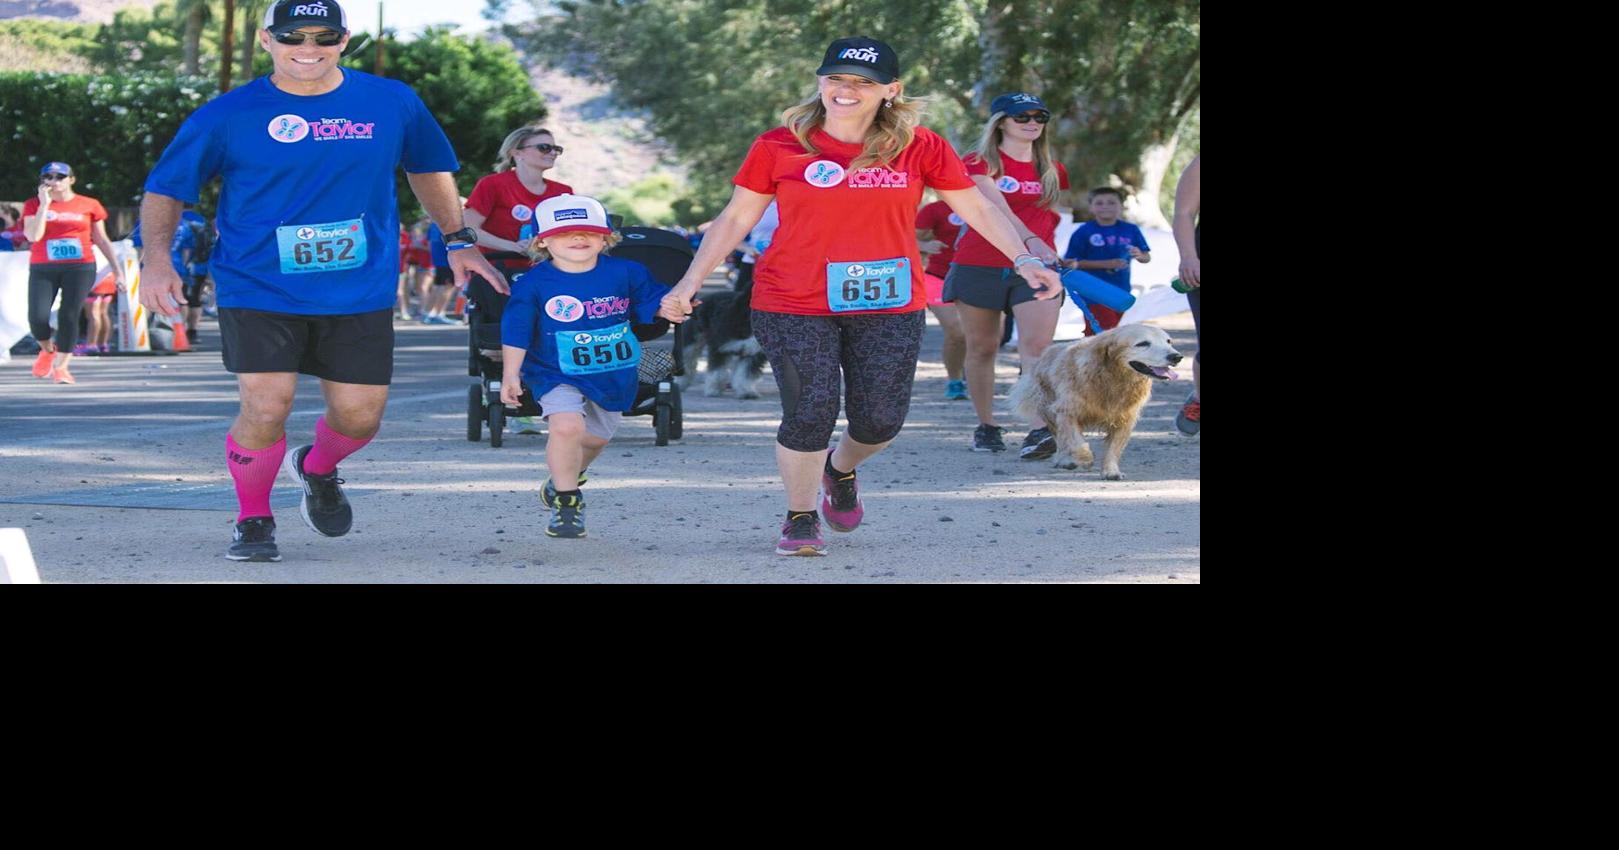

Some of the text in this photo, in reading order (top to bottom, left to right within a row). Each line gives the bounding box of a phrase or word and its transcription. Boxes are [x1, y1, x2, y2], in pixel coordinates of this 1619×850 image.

[838, 47, 878, 63] iRun
[308, 120, 375, 138] Taylor
[315, 229, 349, 238] Taylor
[51, 245, 77, 257] 200
[294, 238, 355, 265] 652
[866, 266, 896, 276] Taylor
[842, 276, 899, 302] 651
[572, 340, 632, 366] 650
